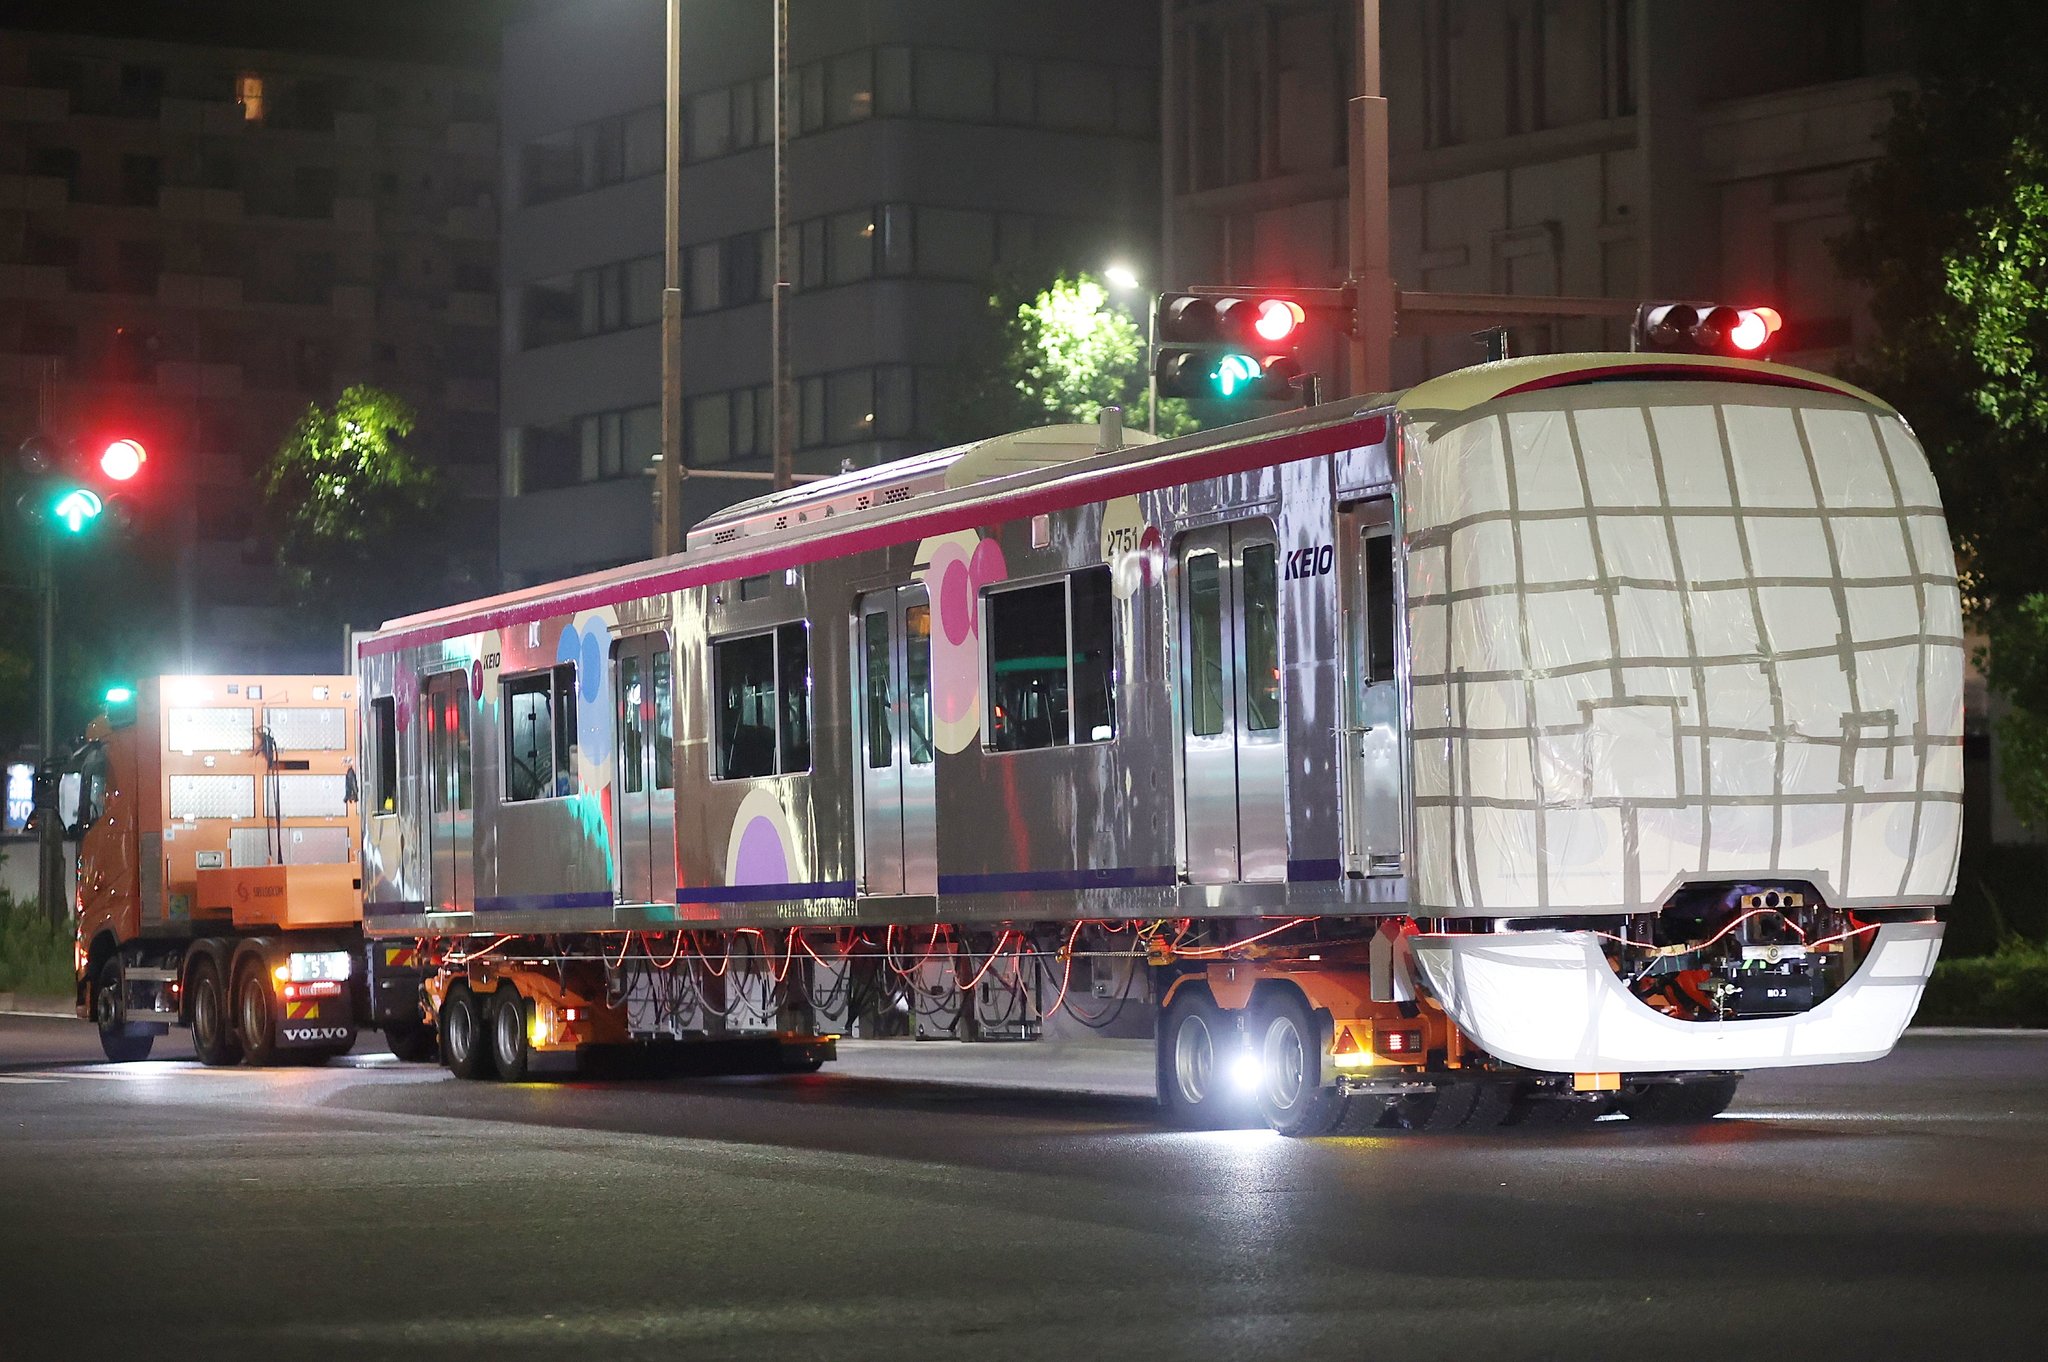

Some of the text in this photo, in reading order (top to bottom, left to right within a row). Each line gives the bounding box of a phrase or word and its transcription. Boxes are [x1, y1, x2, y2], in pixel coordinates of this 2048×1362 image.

[1108, 527, 1138, 556] 2751
[1285, 544, 1333, 580] KEIO
[483, 652, 500, 670] KEIO
[475, 668, 479, 690] 1
[283, 1027, 348, 1041] VOLVO
